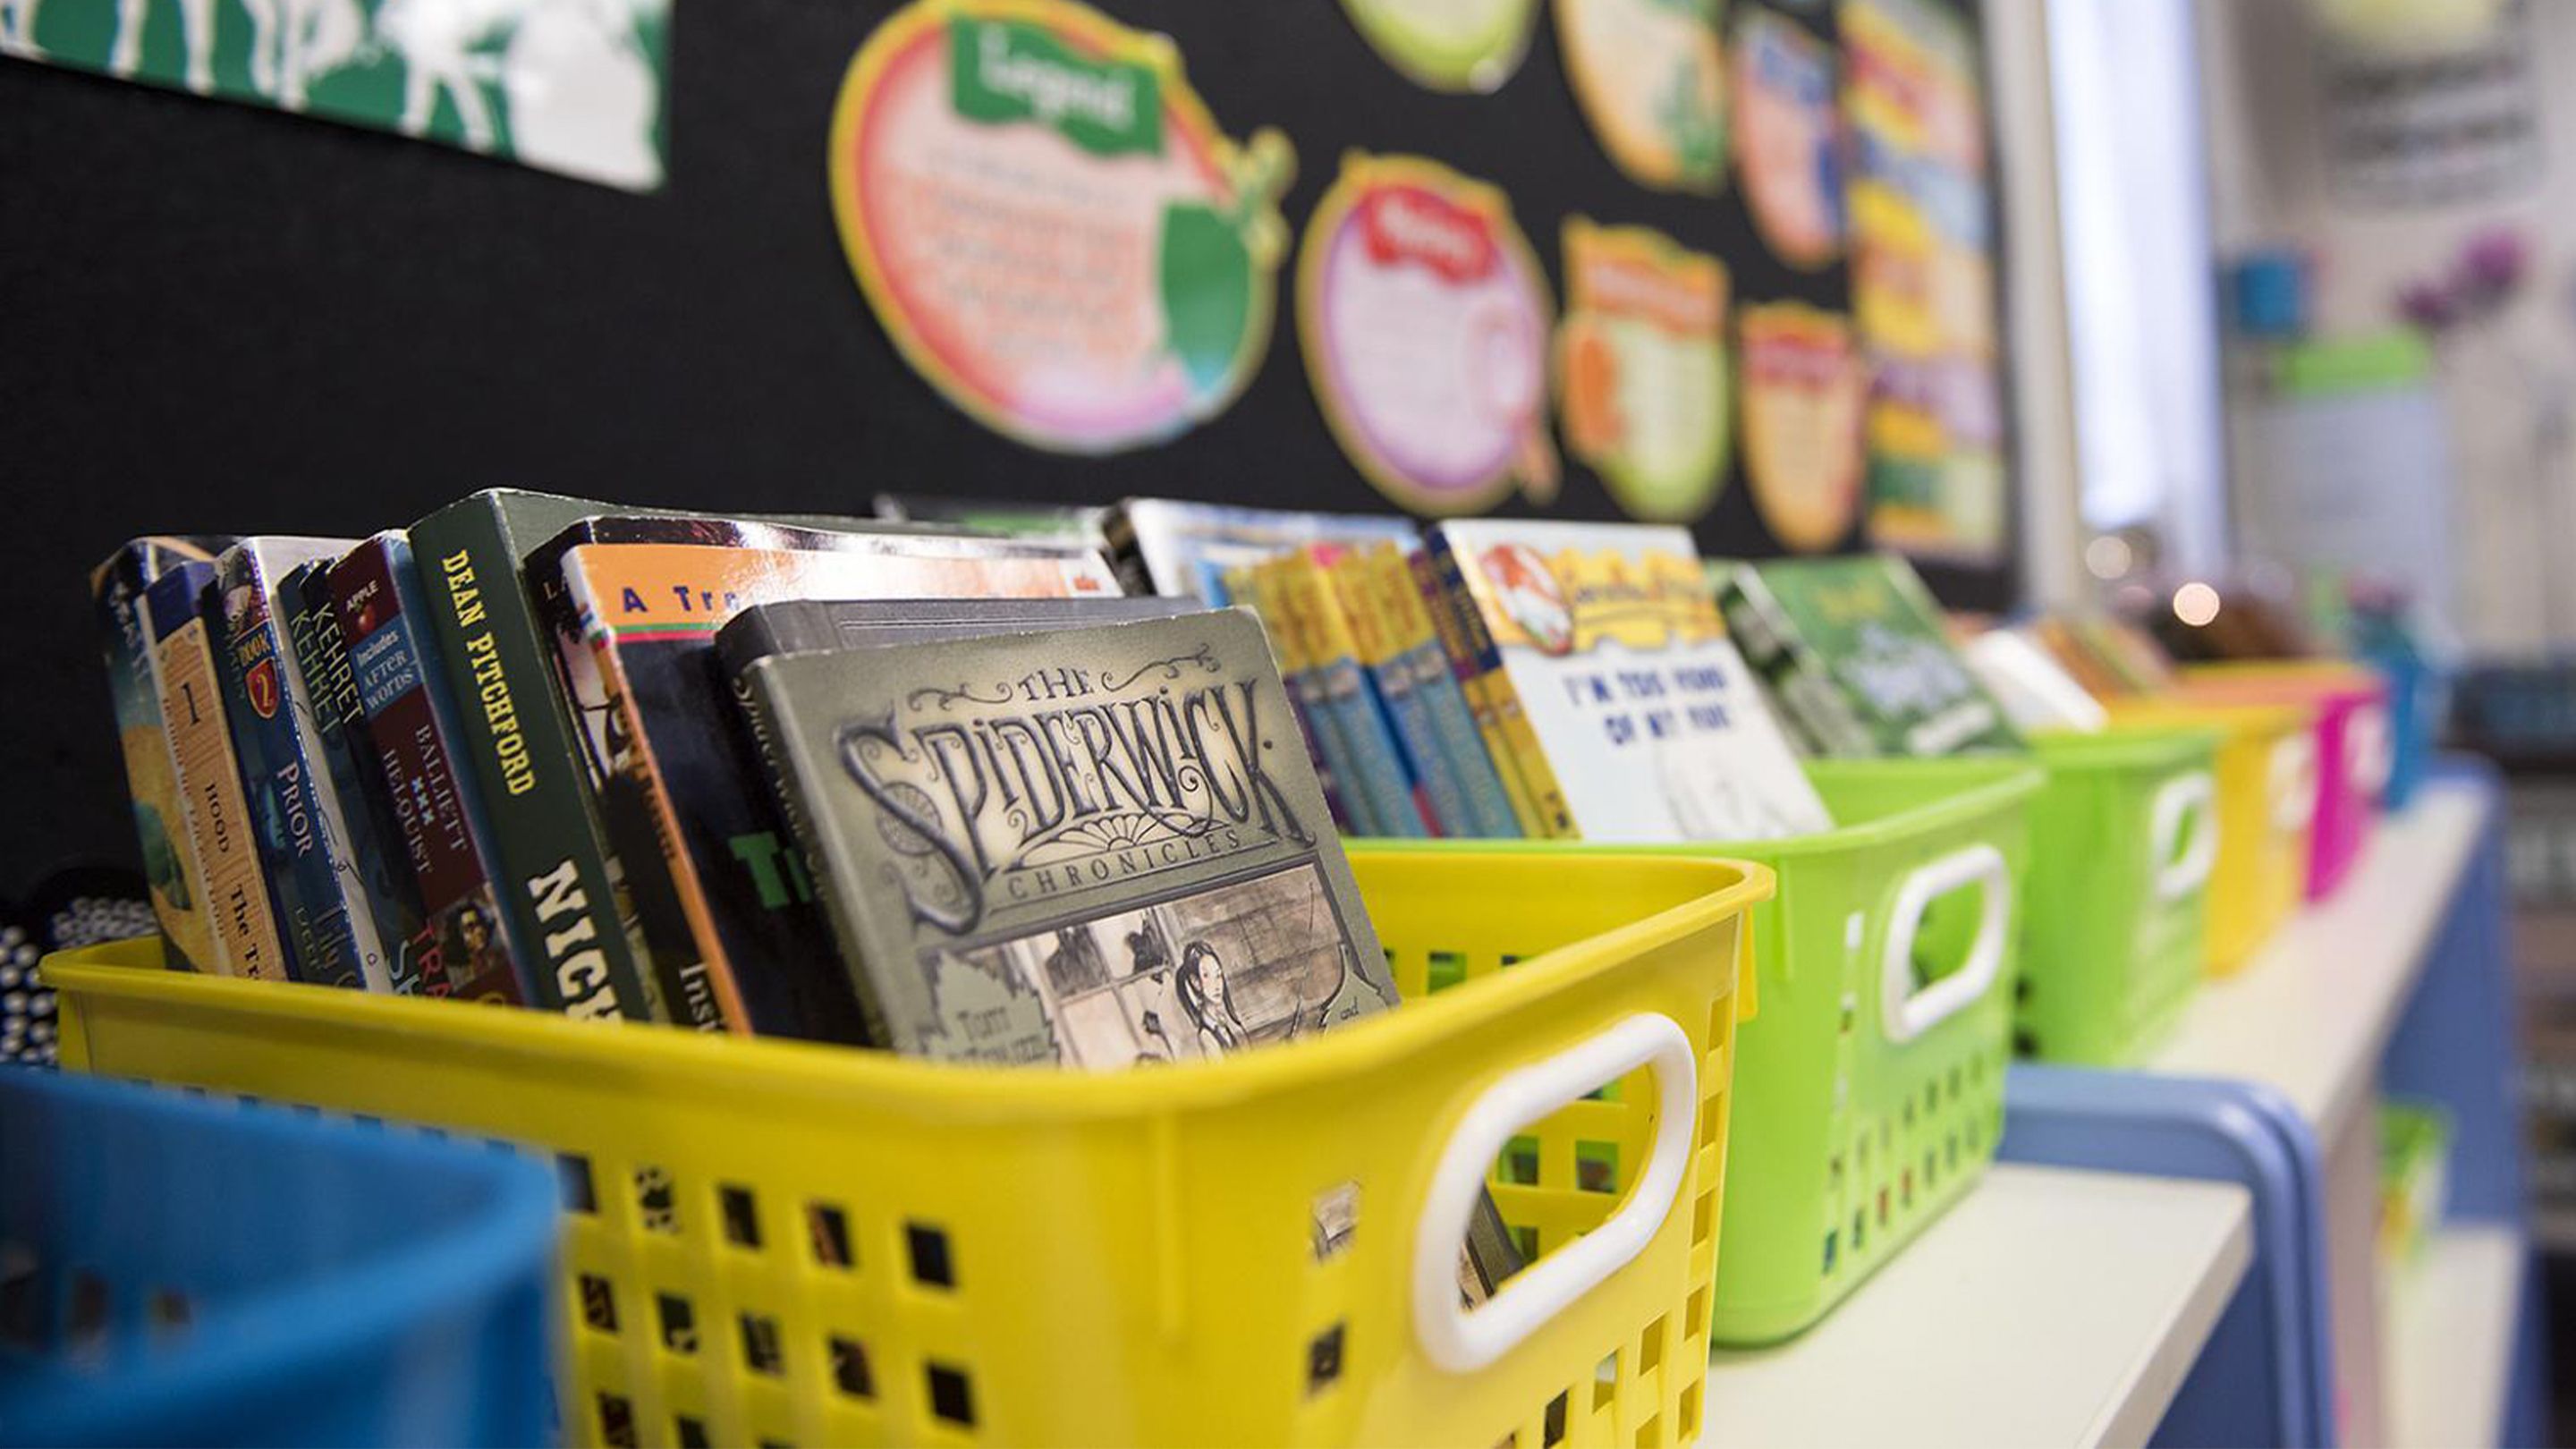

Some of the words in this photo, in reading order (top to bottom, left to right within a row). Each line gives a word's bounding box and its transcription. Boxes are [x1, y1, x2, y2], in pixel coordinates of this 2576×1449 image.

[977, 21, 1136, 131] Legend
[345, 580, 379, 613] APPLE
[623, 587, 648, 613] A
[257, 673, 271, 708] 2
[312, 601, 365, 724] KEHRET
[442, 549, 487, 627] DEAN
[466, 631, 537, 796] PITCHFORD
[1017, 667, 1095, 702] THE
[204, 783, 230, 853] HOOD
[276, 760, 313, 858] PRIOR
[383, 748, 433, 874] HELQUIST
[415, 724, 468, 850] BALLIETT
[1006, 828, 1241, 898] CHRONICLES
[231, 882, 250, 936] The
